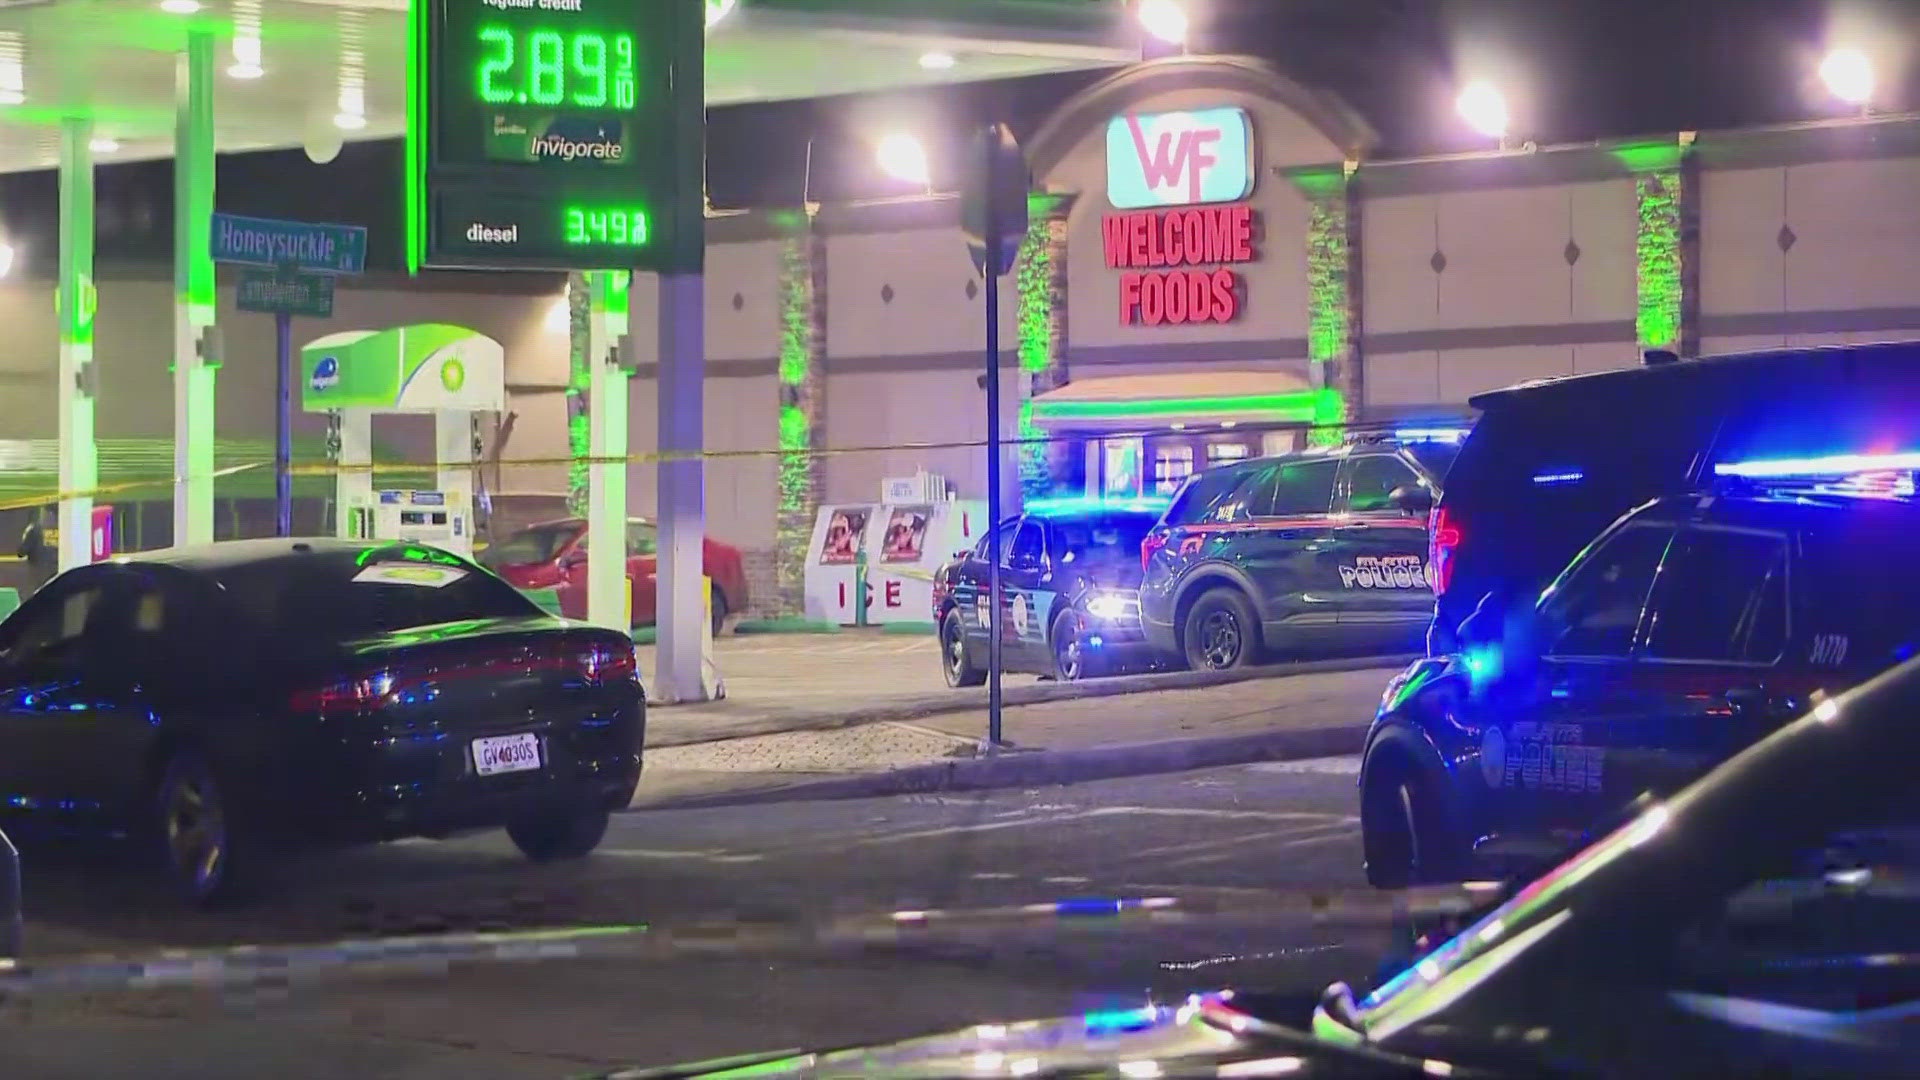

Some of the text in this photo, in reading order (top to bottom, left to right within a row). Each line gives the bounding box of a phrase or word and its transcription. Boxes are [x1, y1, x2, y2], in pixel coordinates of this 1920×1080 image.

[479, 28, 607, 107] 2.89
[531, 136, 622, 161] Invigorate
[1126, 111, 1222, 204] WF
[220, 219, 335, 266] Honeysuckle
[466, 223, 518, 243] diesel
[1102, 205, 1253, 270] WELCOME
[1120, 268, 1237, 326] FOODS
[1338, 565, 1427, 589] POLICE
